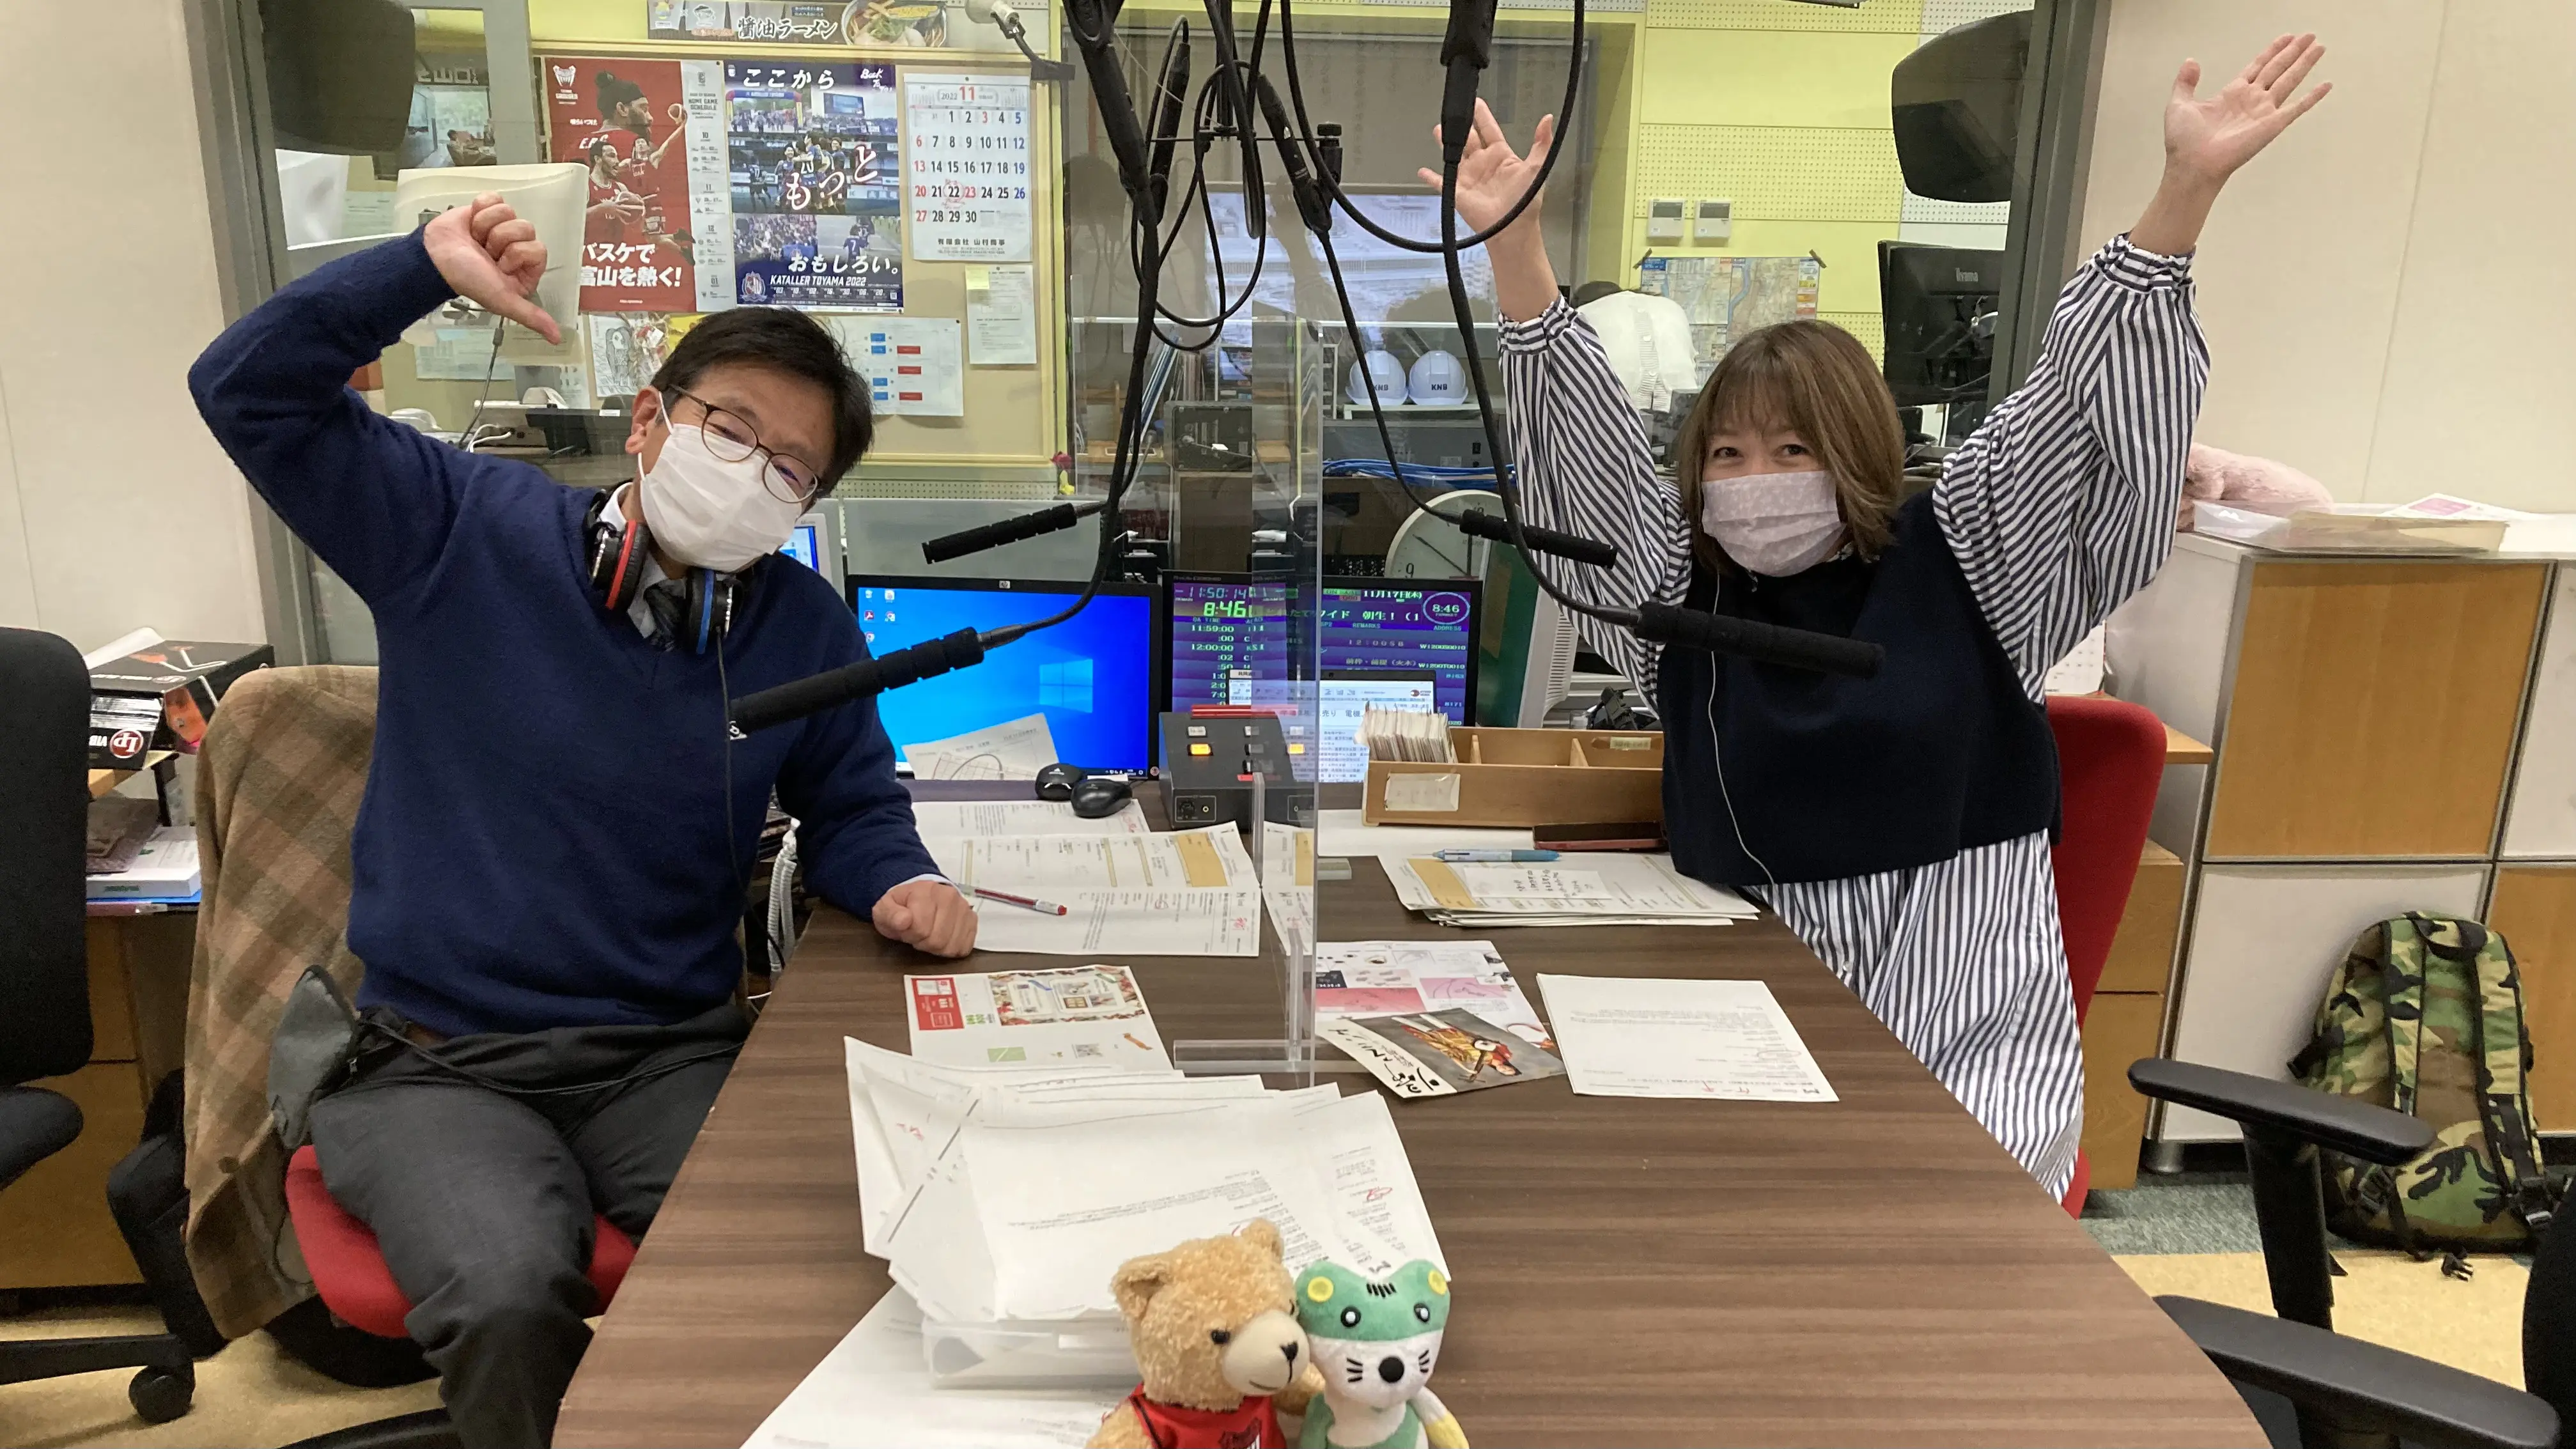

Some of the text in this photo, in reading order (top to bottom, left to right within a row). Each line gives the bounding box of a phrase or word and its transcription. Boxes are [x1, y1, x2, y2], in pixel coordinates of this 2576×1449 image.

[743, 68, 835, 89] ここから
[940, 92, 958, 100] 2022
[959, 86, 975, 101] 11
[949, 111, 954, 123] 1
[965, 111, 972, 123] 2
[982, 111, 988, 123] 3
[998, 111, 1004, 124] 4
[1015, 112, 1021, 124] 5
[916, 135, 1025, 150] 6 7 8 9 10 11 12
[914, 160, 1025, 174] 13 14 15 16 17 18 19
[786, 145, 878, 210] もっと
[915, 185, 1025, 199] 20 21 22 23 24 25 26
[915, 210, 977, 223] 27 28 29 30
[582, 242, 656, 264] バスケで
[788, 254, 898, 275] おもしろい。
[770, 275, 867, 286] KATALLER TOYAMA 2022
[1406, 562, 1415, 578] 9
[1203, 600, 1247, 617] 8:46
[1432, 603, 1461, 614] 8:46
